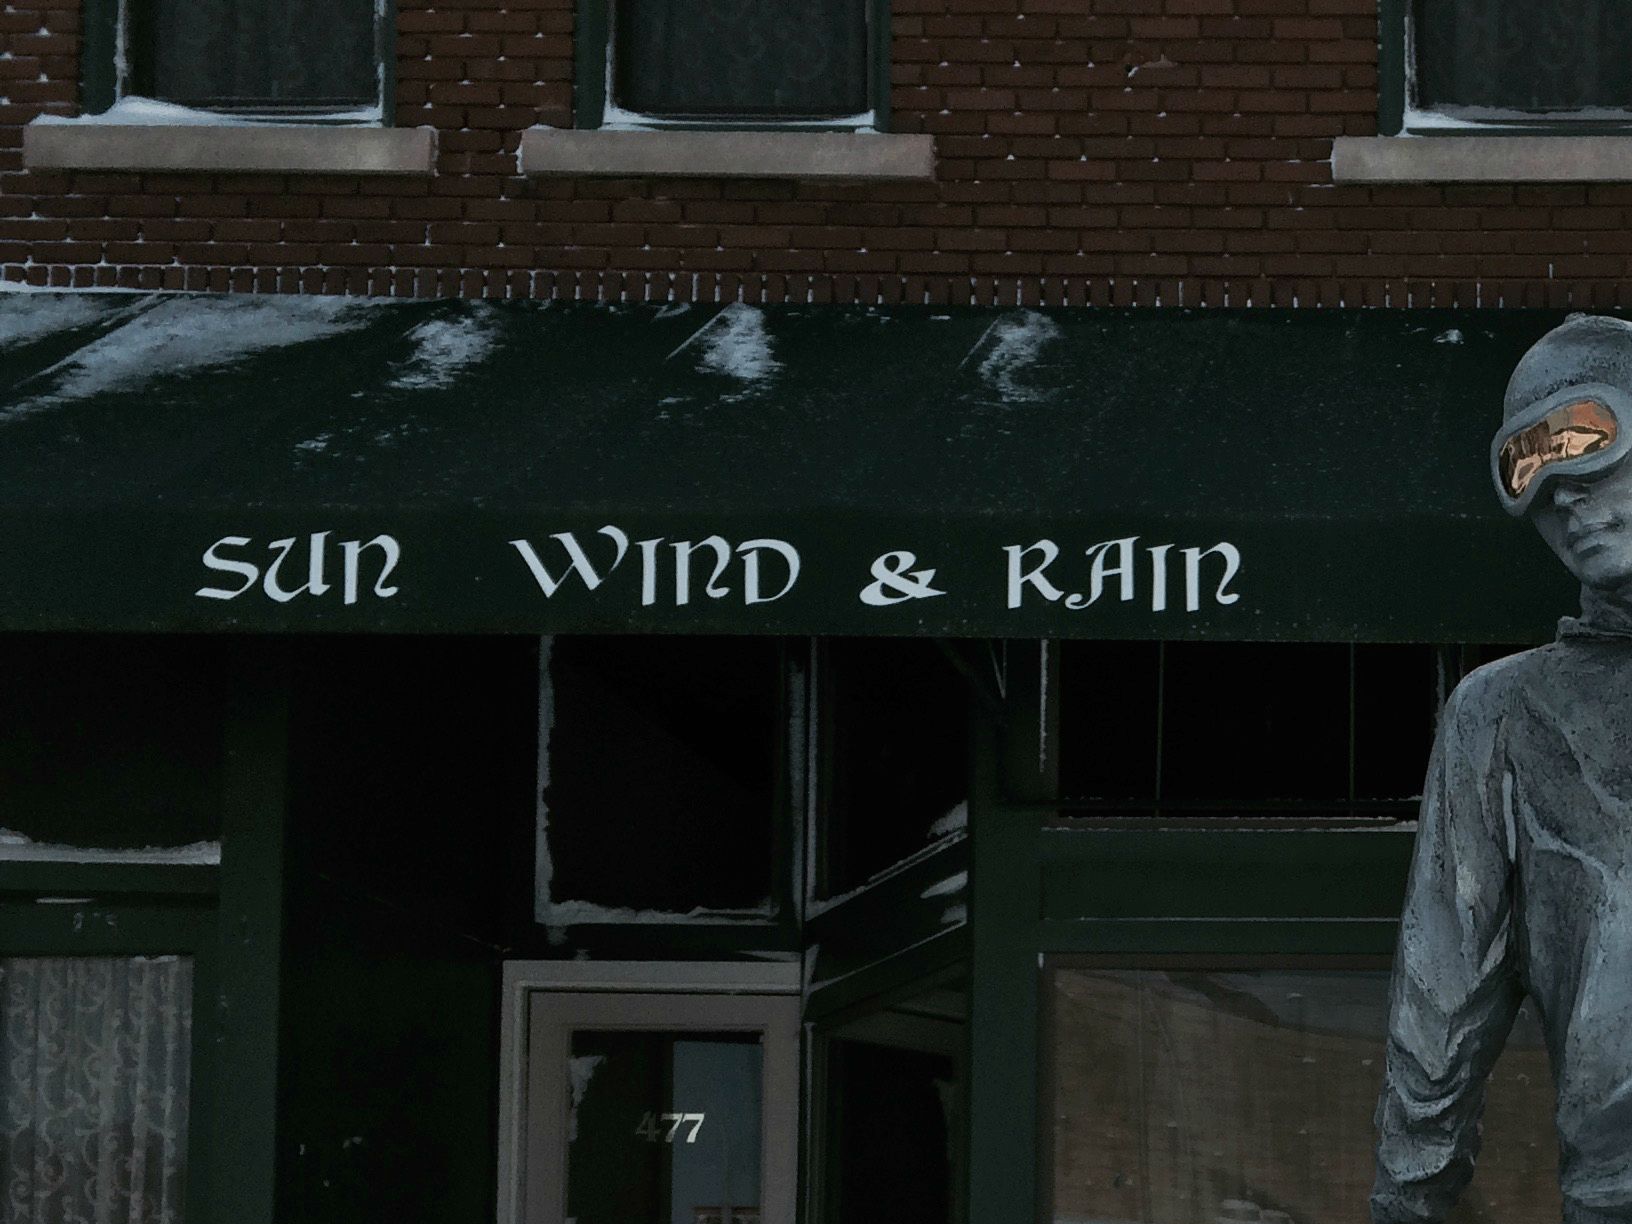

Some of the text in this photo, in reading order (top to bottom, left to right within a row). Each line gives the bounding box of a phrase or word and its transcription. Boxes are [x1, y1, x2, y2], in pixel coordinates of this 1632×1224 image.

[194, 524, 1242, 613] SUN WIND & RAIN
[635, 1111, 706, 1144] 477
